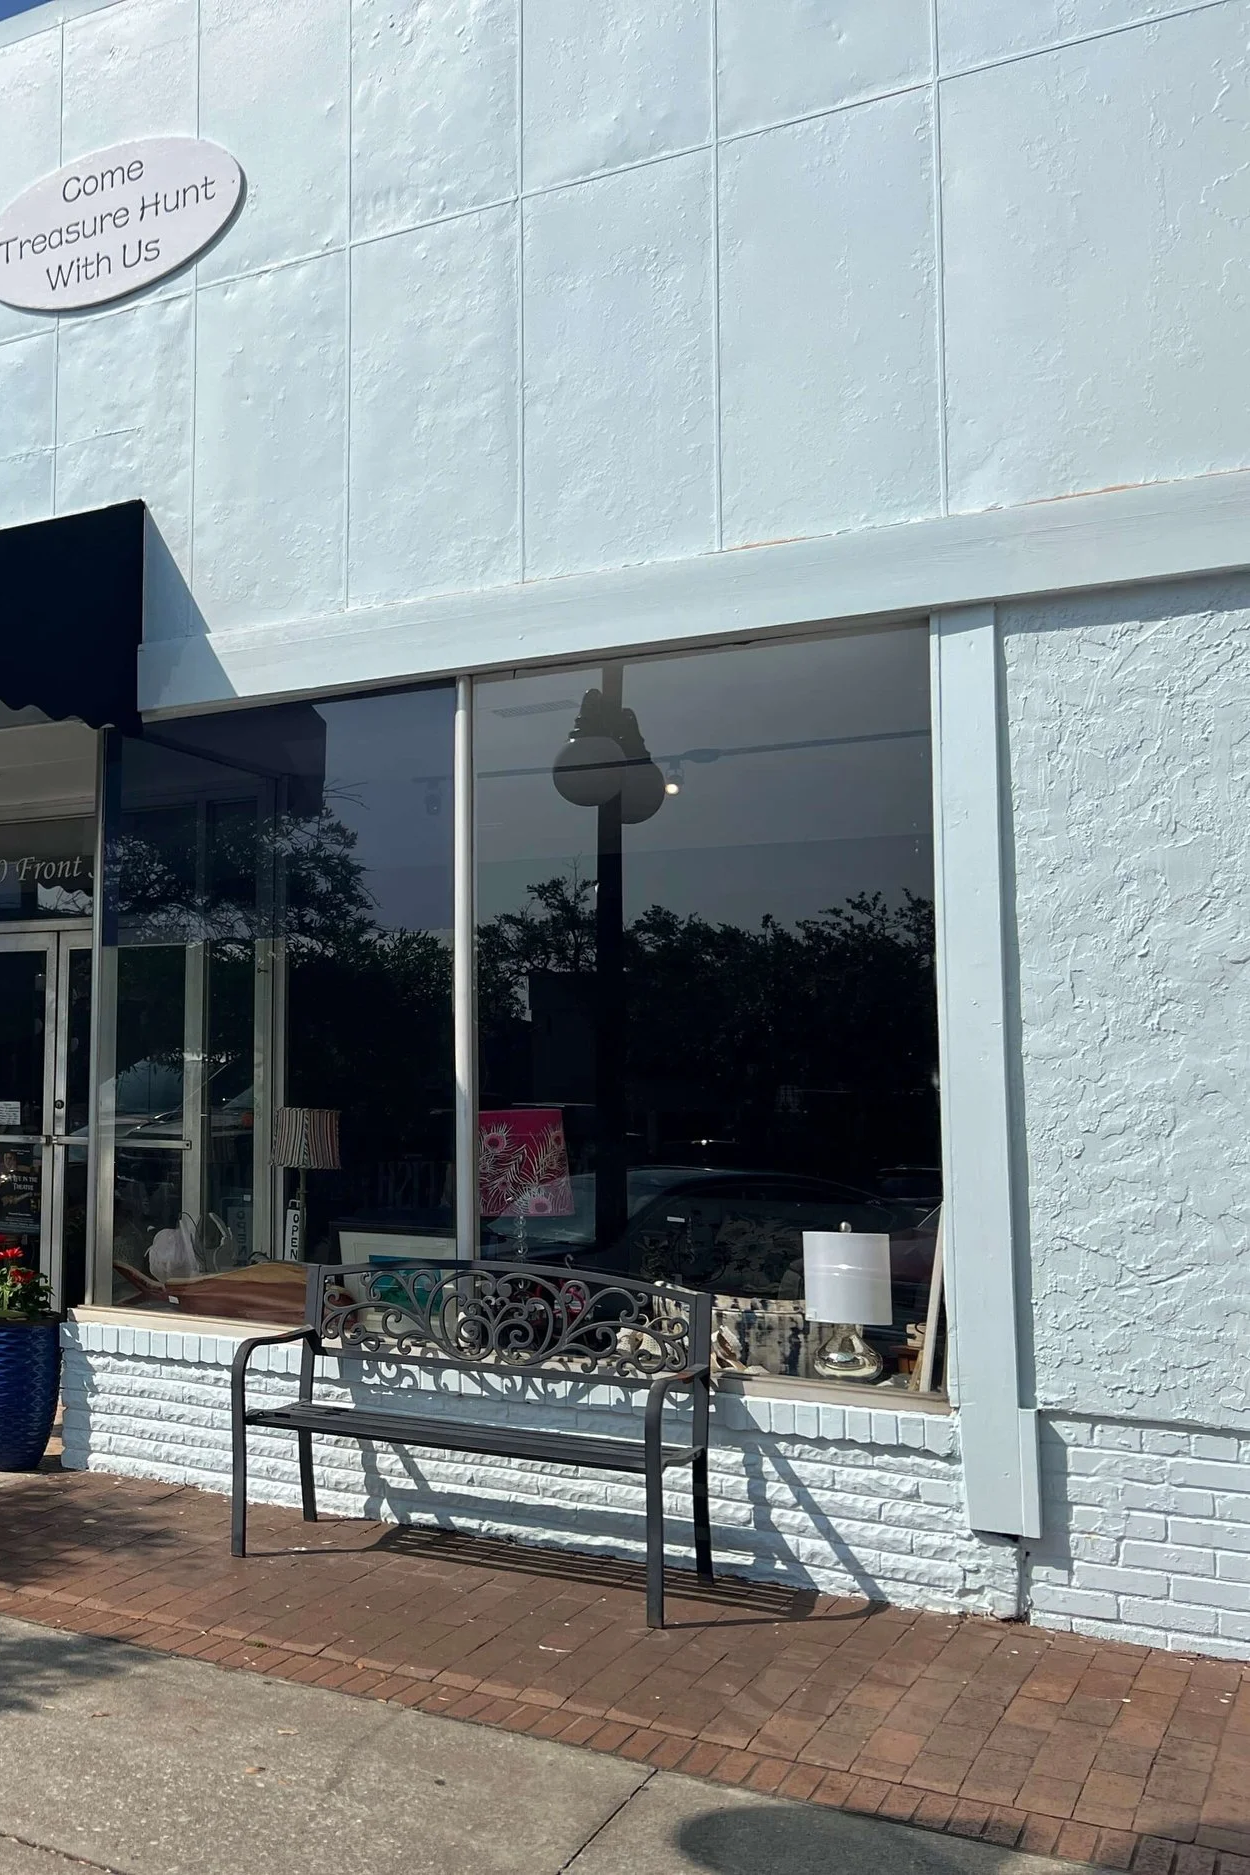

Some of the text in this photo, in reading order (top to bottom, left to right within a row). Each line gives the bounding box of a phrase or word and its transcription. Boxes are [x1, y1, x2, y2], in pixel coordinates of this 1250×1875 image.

[62, 159, 144, 203] Come
[139, 175, 216, 222] Hunt
[45, 238, 161, 291] With Us
[15, 856, 82, 882] Front
[290, 1213, 300, 1260] OPEN
